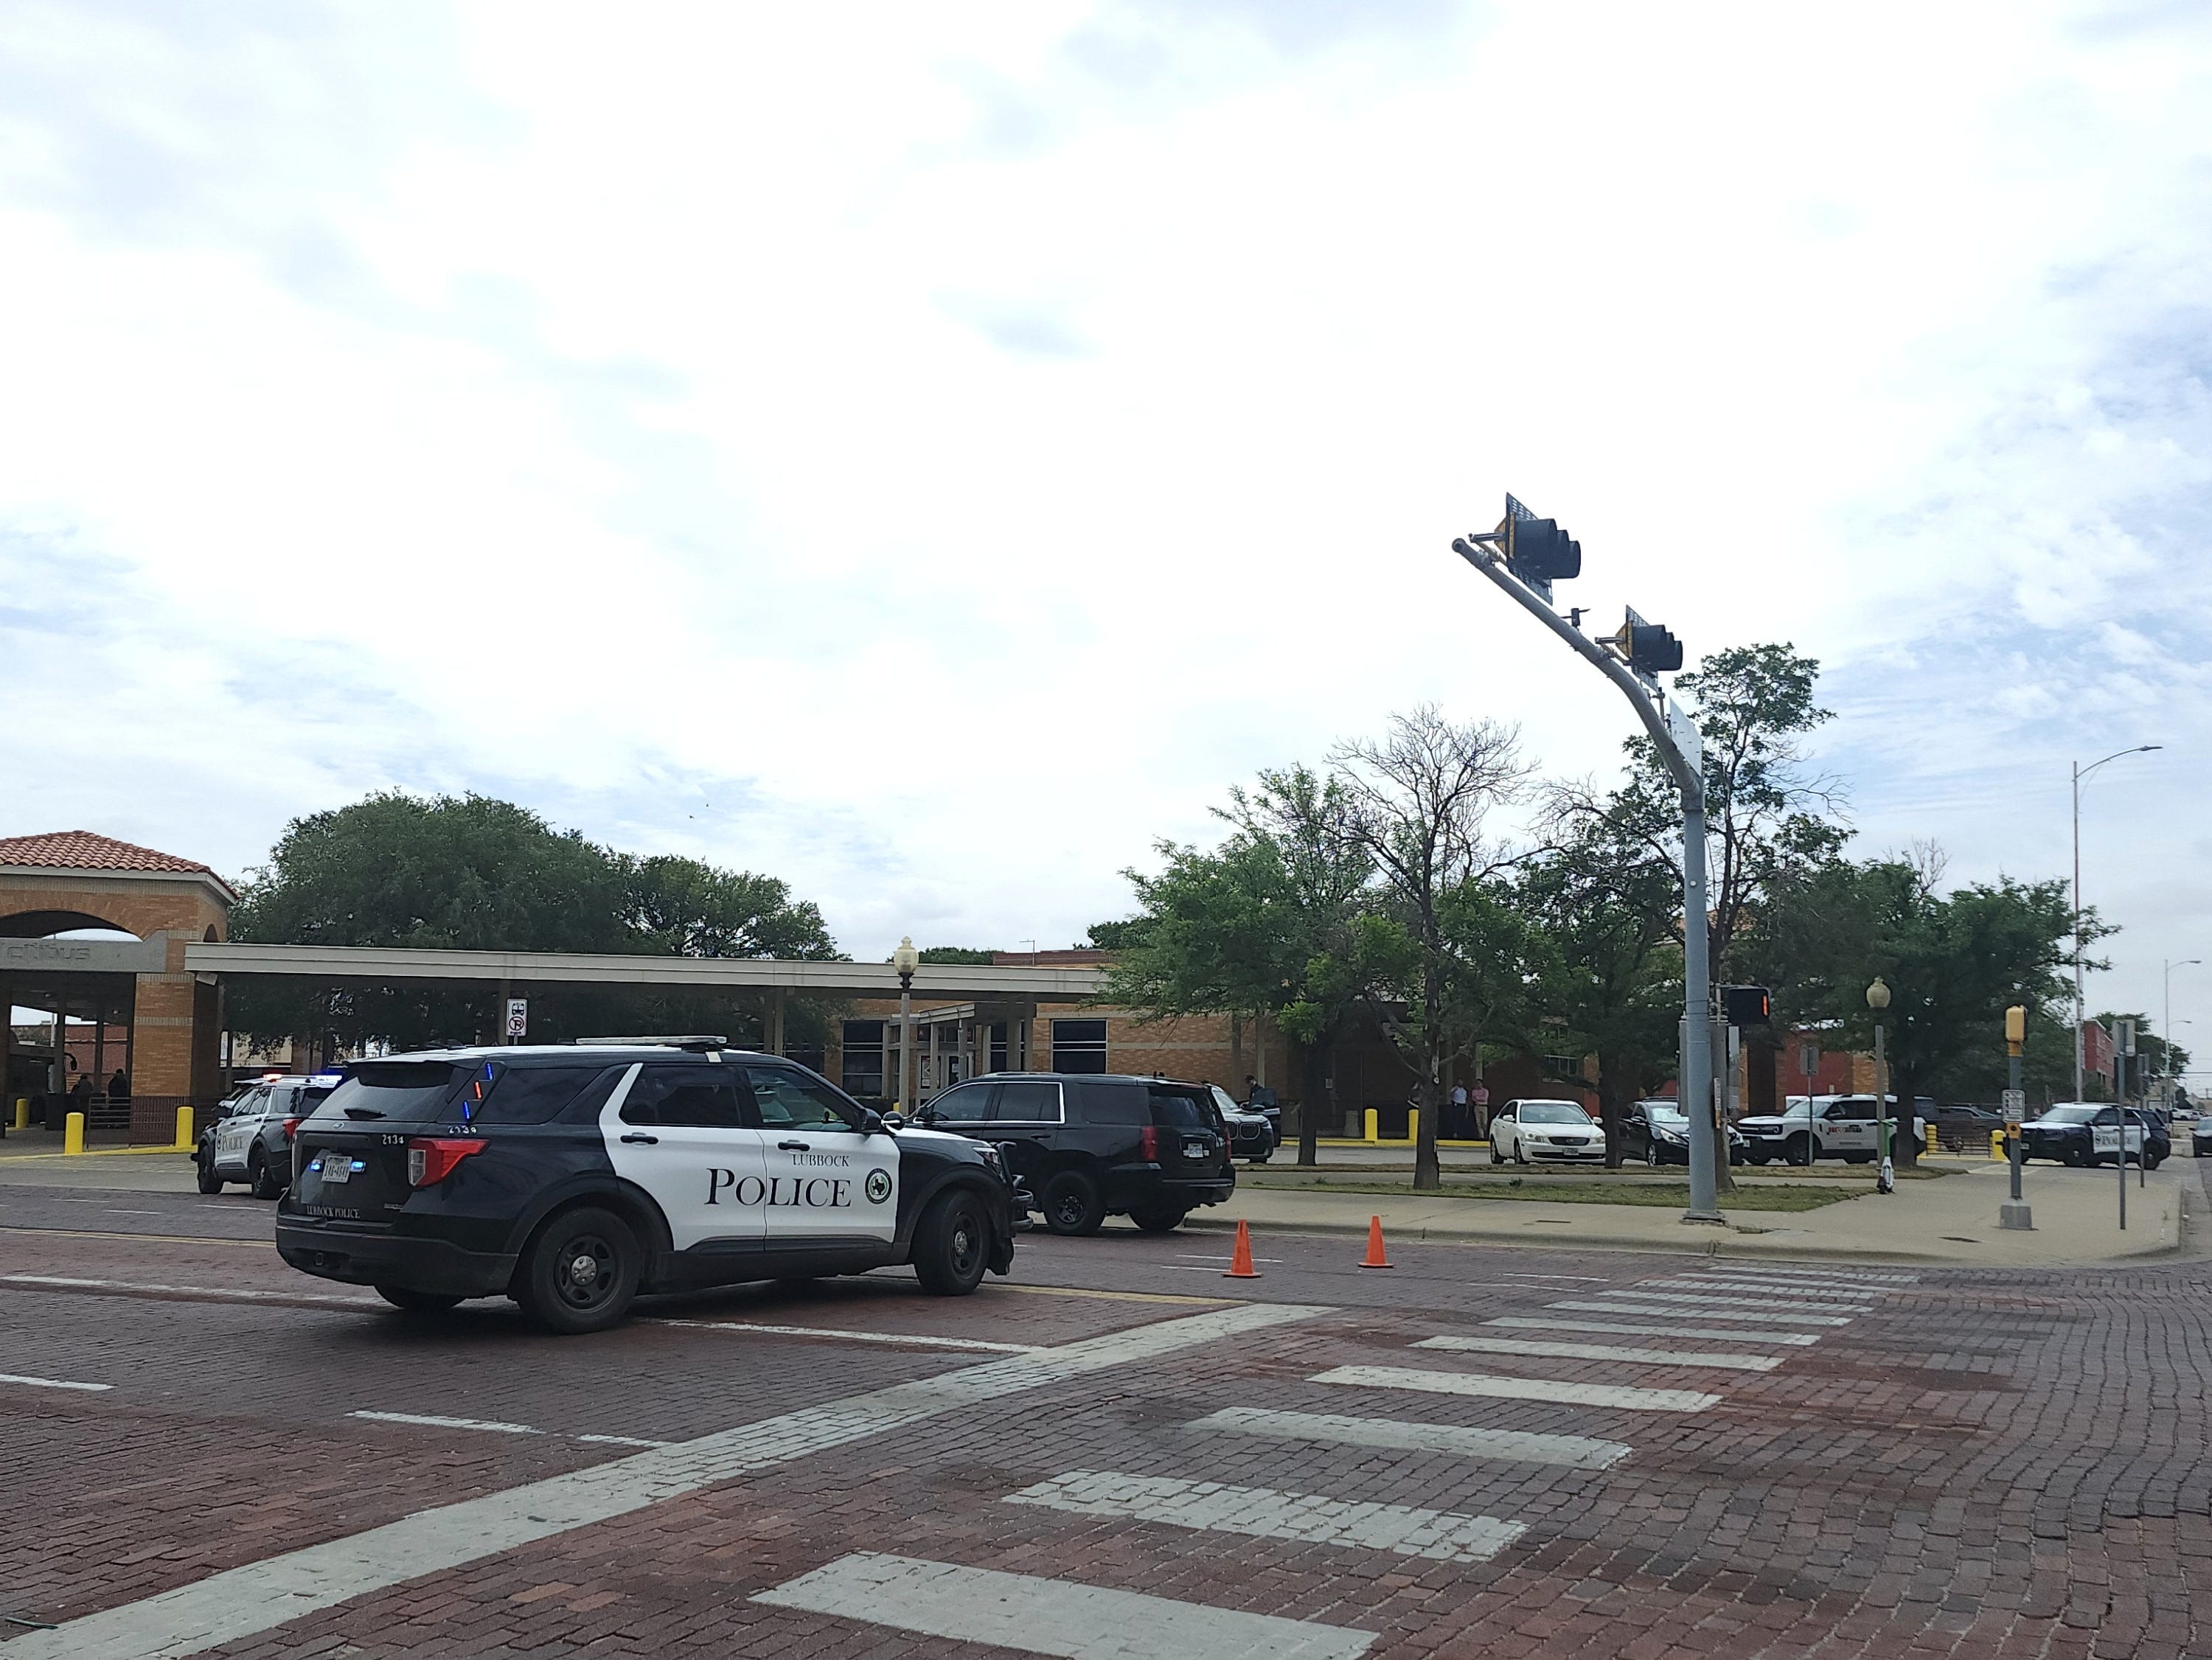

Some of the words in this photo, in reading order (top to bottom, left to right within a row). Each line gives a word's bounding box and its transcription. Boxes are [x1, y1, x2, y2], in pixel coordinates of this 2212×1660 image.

[793, 1154, 849, 1167] LUBBOCK
[703, 1168, 852, 1207] POLICE
[307, 1205, 334, 1216] LUBBOCK
[335, 1208, 361, 1218] POLICE
